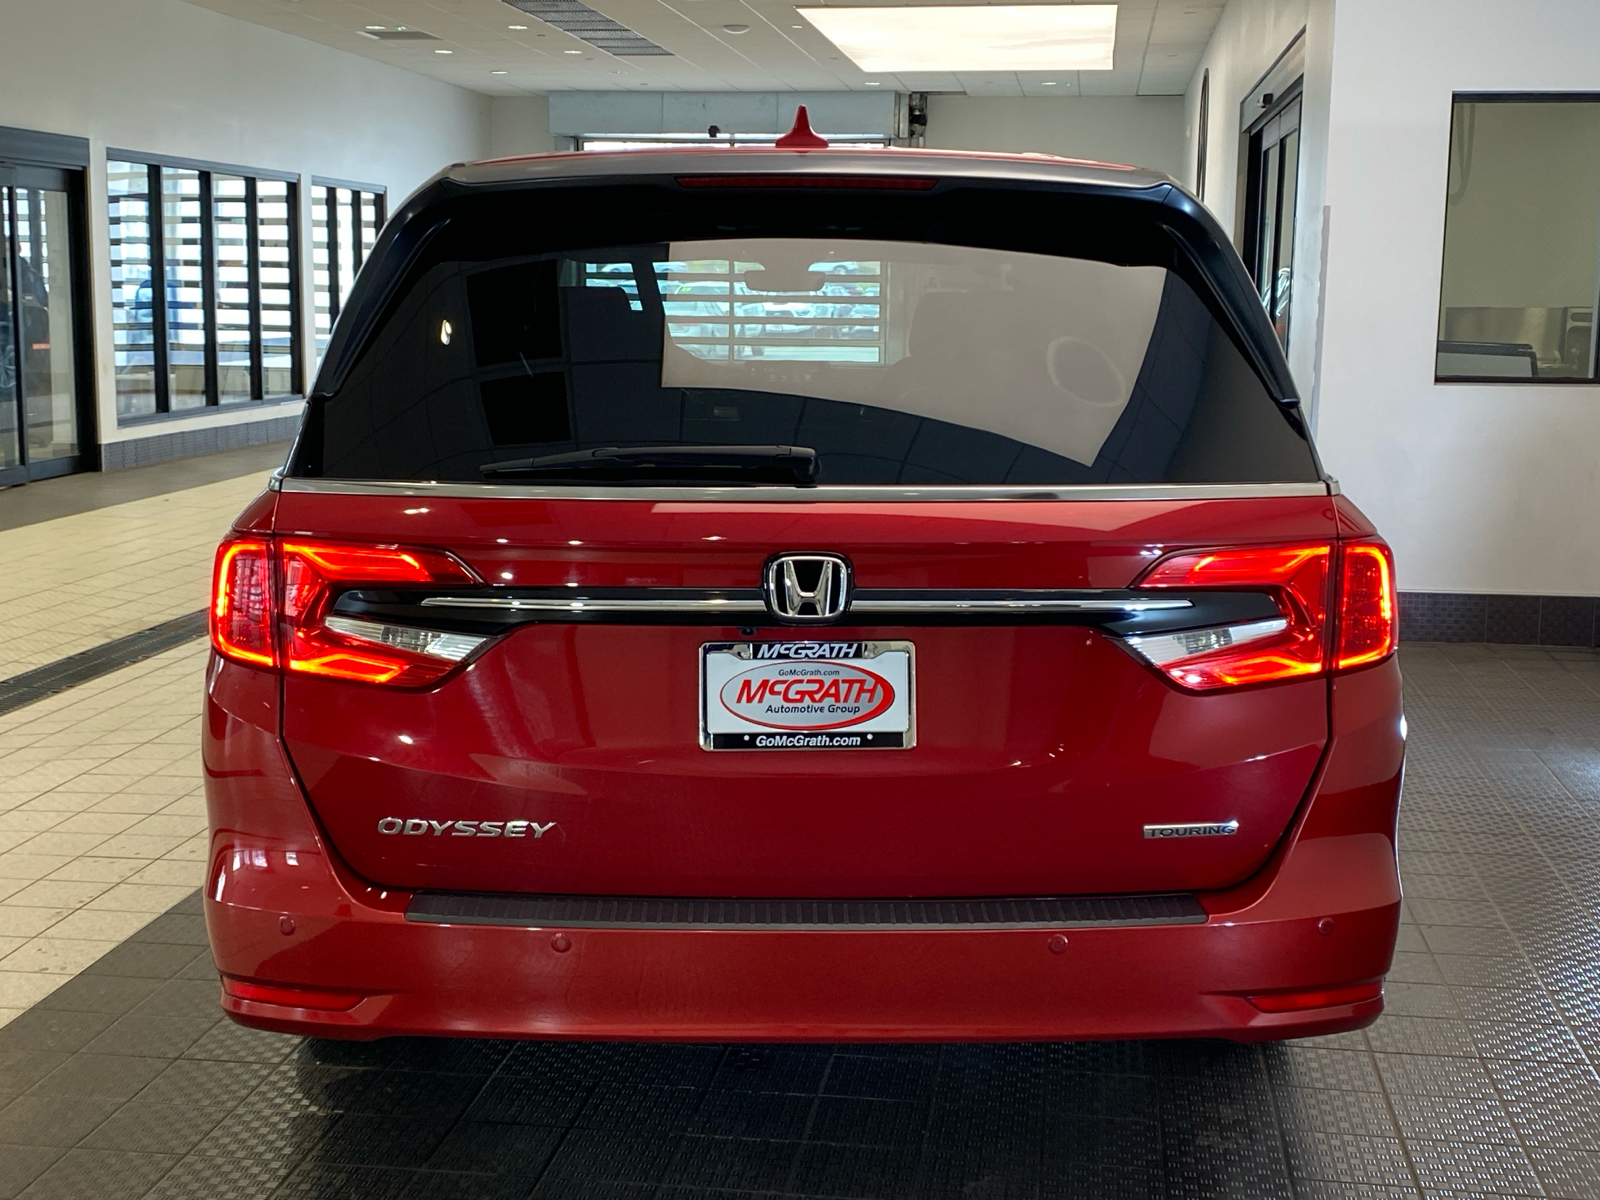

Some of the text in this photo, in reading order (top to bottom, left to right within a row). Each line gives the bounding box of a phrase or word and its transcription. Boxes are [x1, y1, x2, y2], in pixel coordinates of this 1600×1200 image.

[765, 704, 861, 715] Automotive Group
[756, 734, 861, 747] GoMcGrath.com
[377, 817, 557, 839] ODYSSEY
[1147, 825, 1236, 837] TOURING
